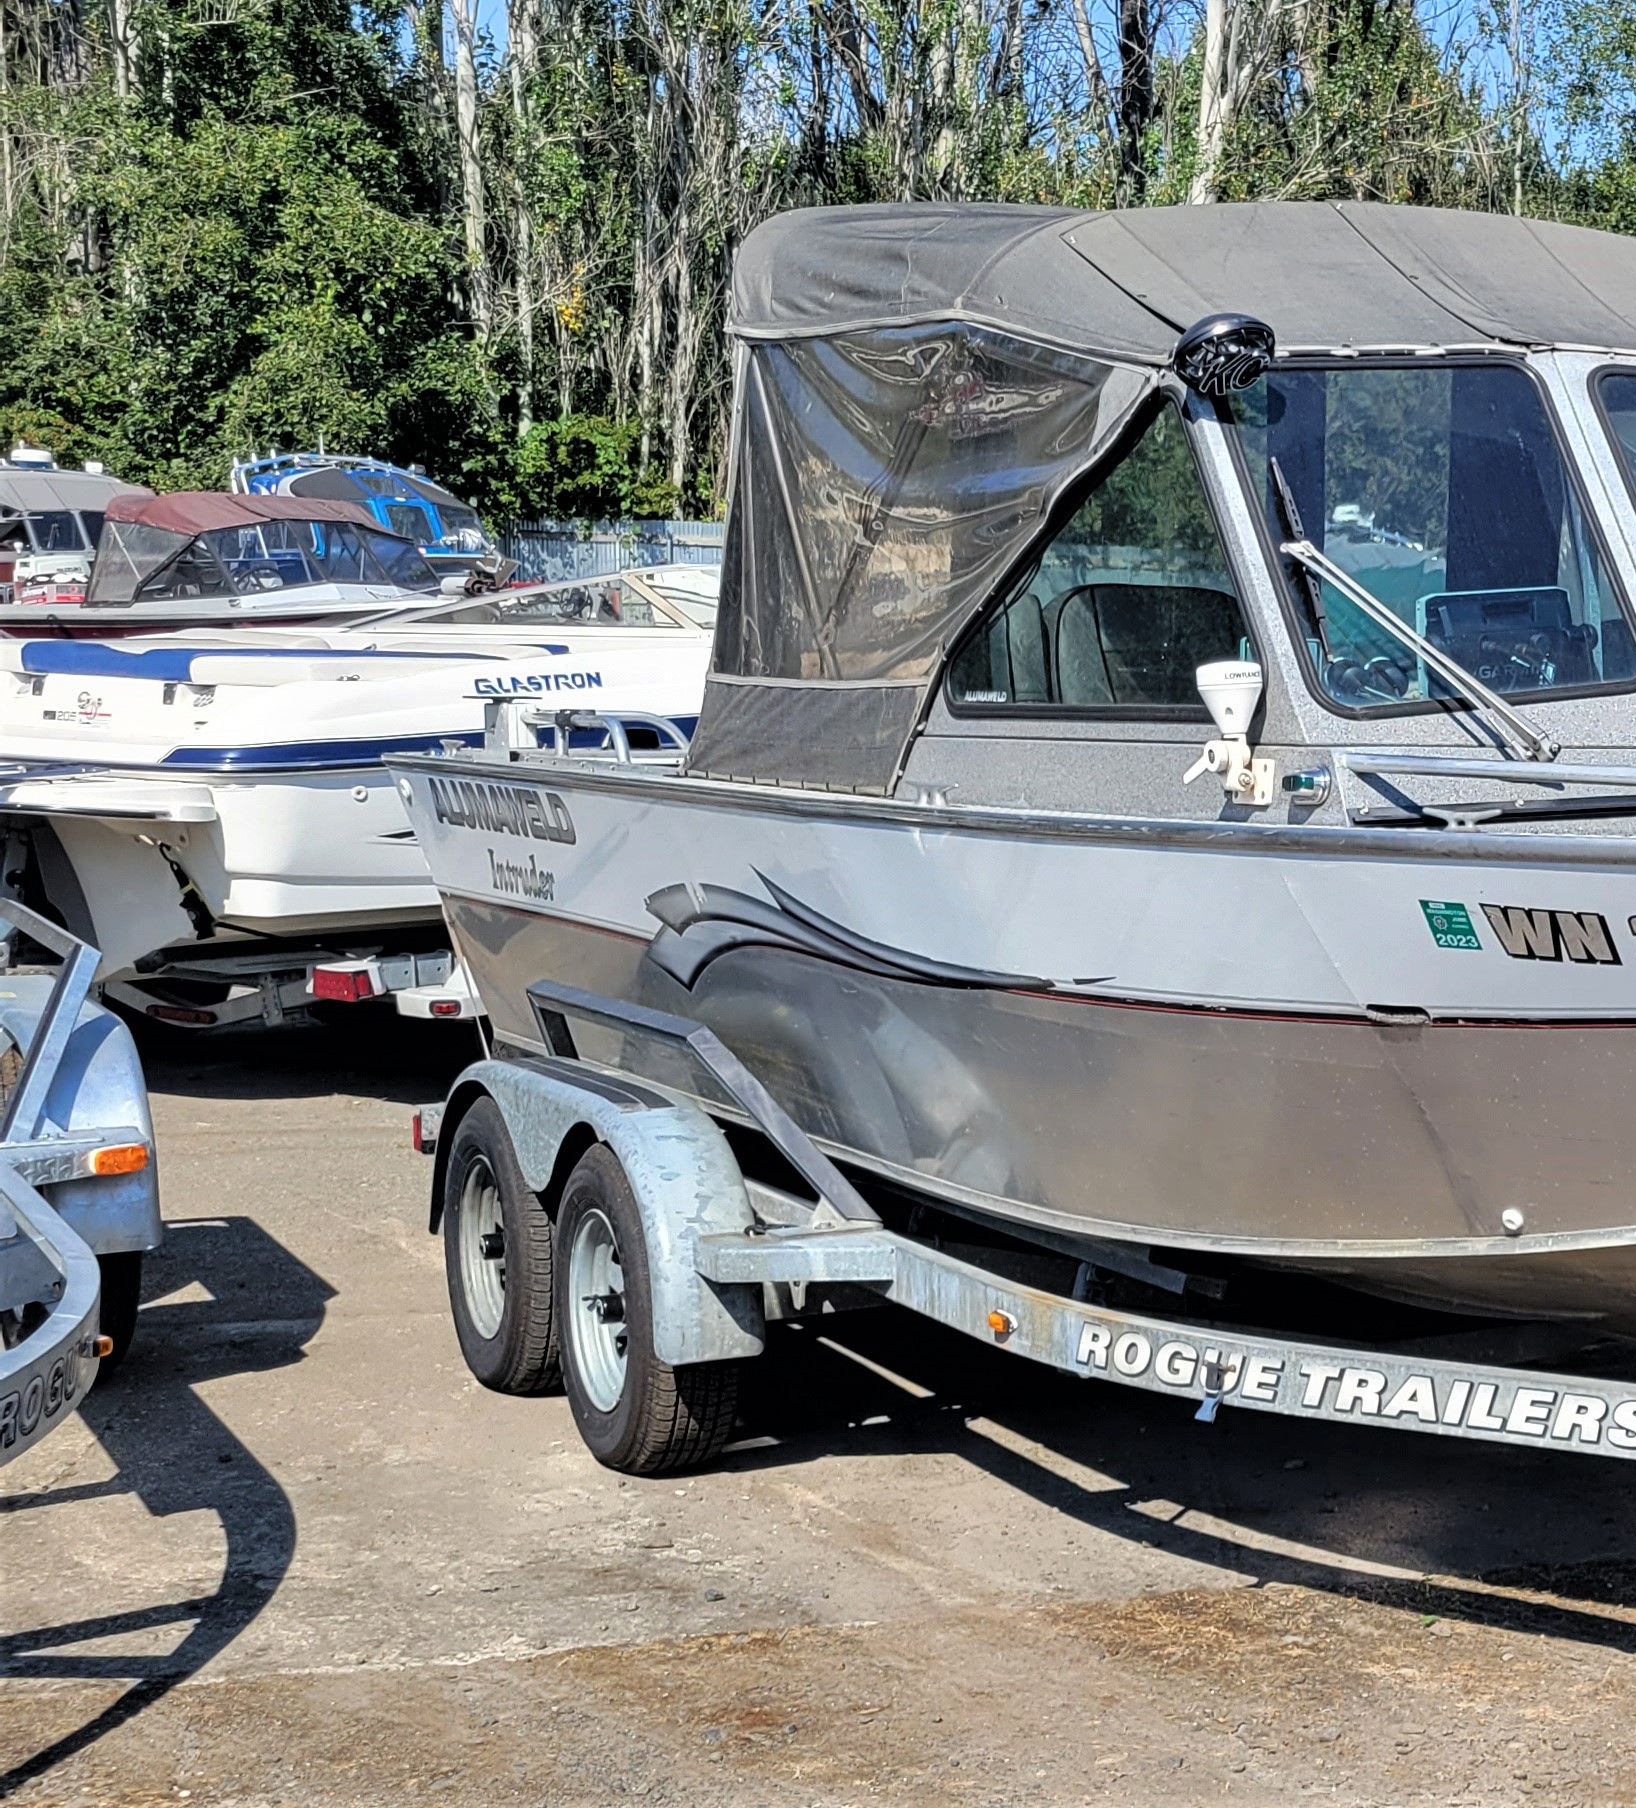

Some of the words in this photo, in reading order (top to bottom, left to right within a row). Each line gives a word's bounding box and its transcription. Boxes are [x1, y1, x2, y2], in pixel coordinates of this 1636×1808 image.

[1198, 352, 1271, 396] KC
[474, 671, 603, 695] GLASTRON
[963, 690, 1007, 702] ALUMAWELD
[428, 777, 576, 846] ALUMAWELD
[487, 848, 556, 902] Intruder
[1436, 933, 1479, 948] 2023
[1478, 902, 1624, 968] WN
[1074, 1322, 1287, 1402] ROGUE
[0, 1341, 80, 1450] ROGU
